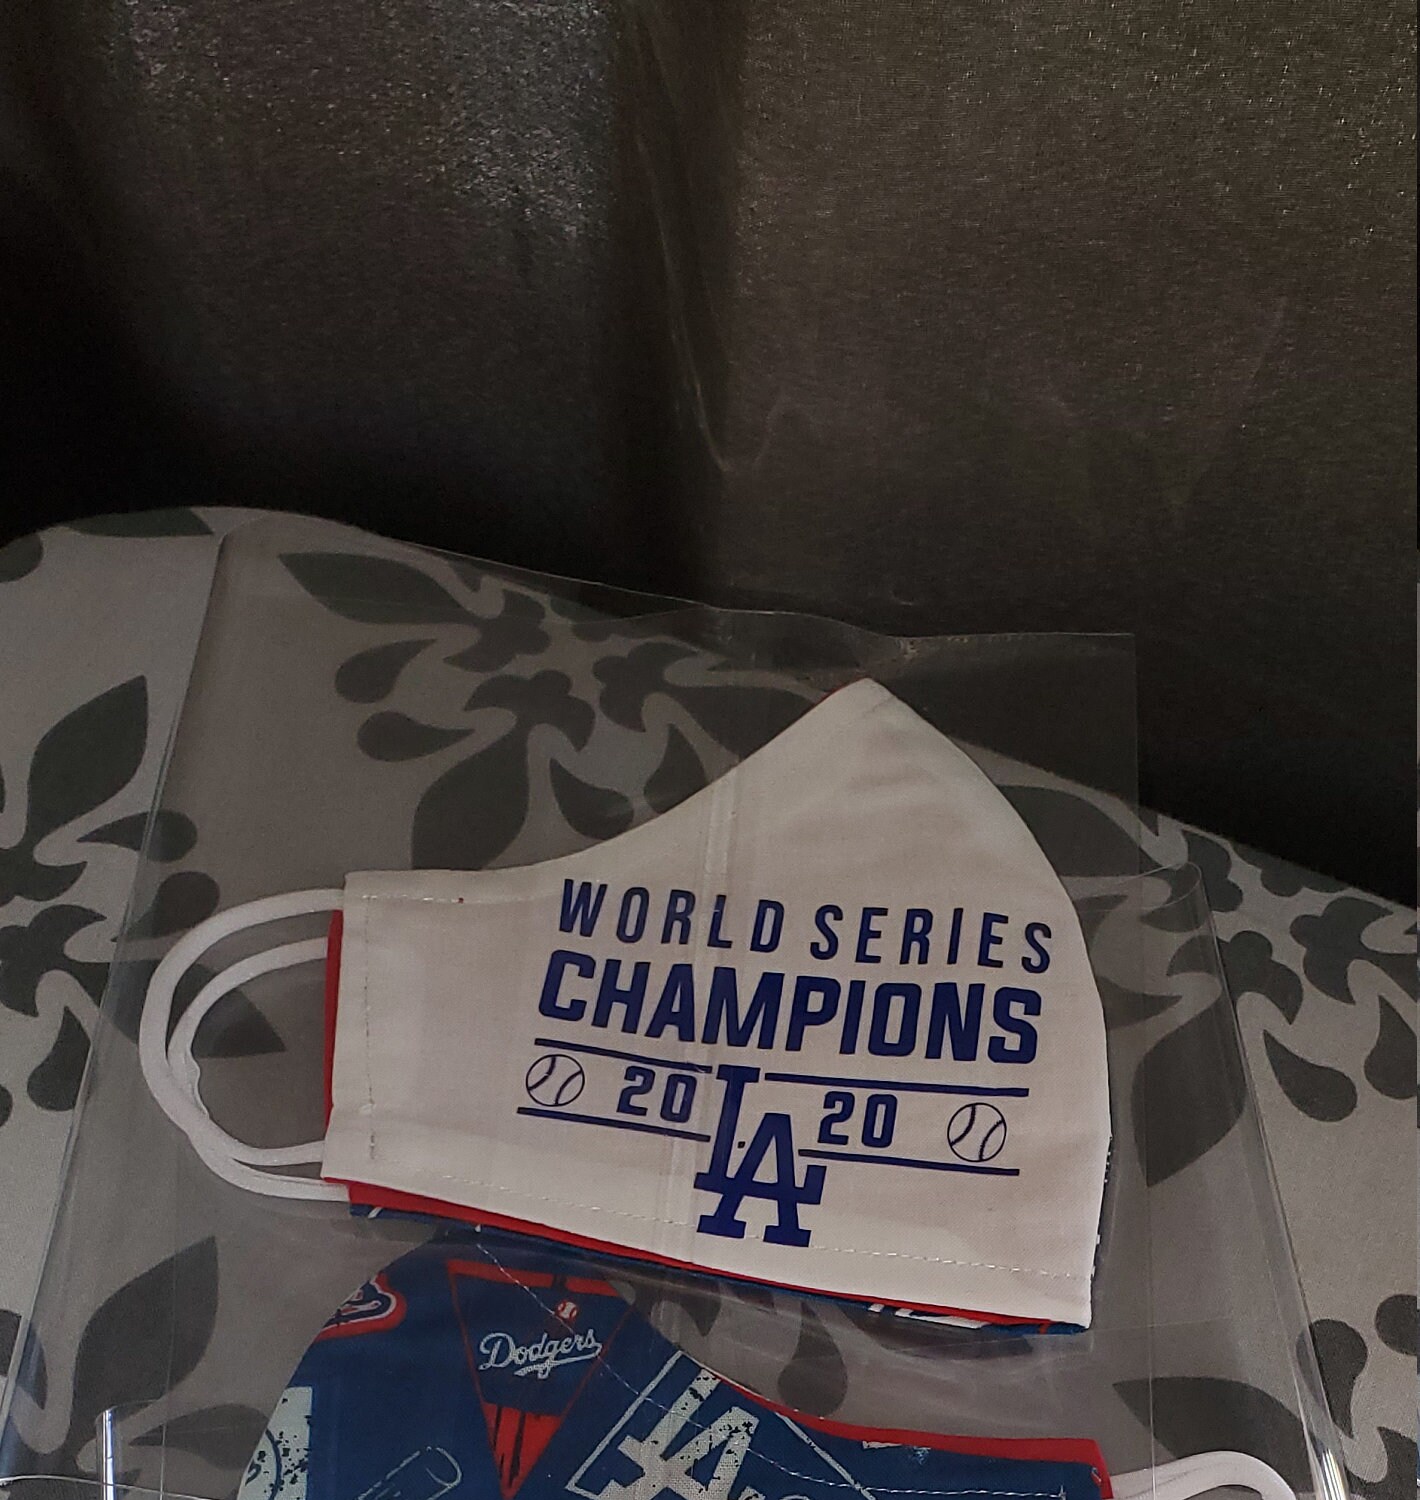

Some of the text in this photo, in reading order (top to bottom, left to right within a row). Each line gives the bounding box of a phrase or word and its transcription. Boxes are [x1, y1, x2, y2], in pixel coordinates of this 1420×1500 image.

[558, 878, 1053, 974] WORLD SERIES
[537, 949, 1043, 1064] CHAMPIONS
[616, 1064, 898, 1248] 20 LA 20
[478, 1328, 602, 1380] Dodgers
